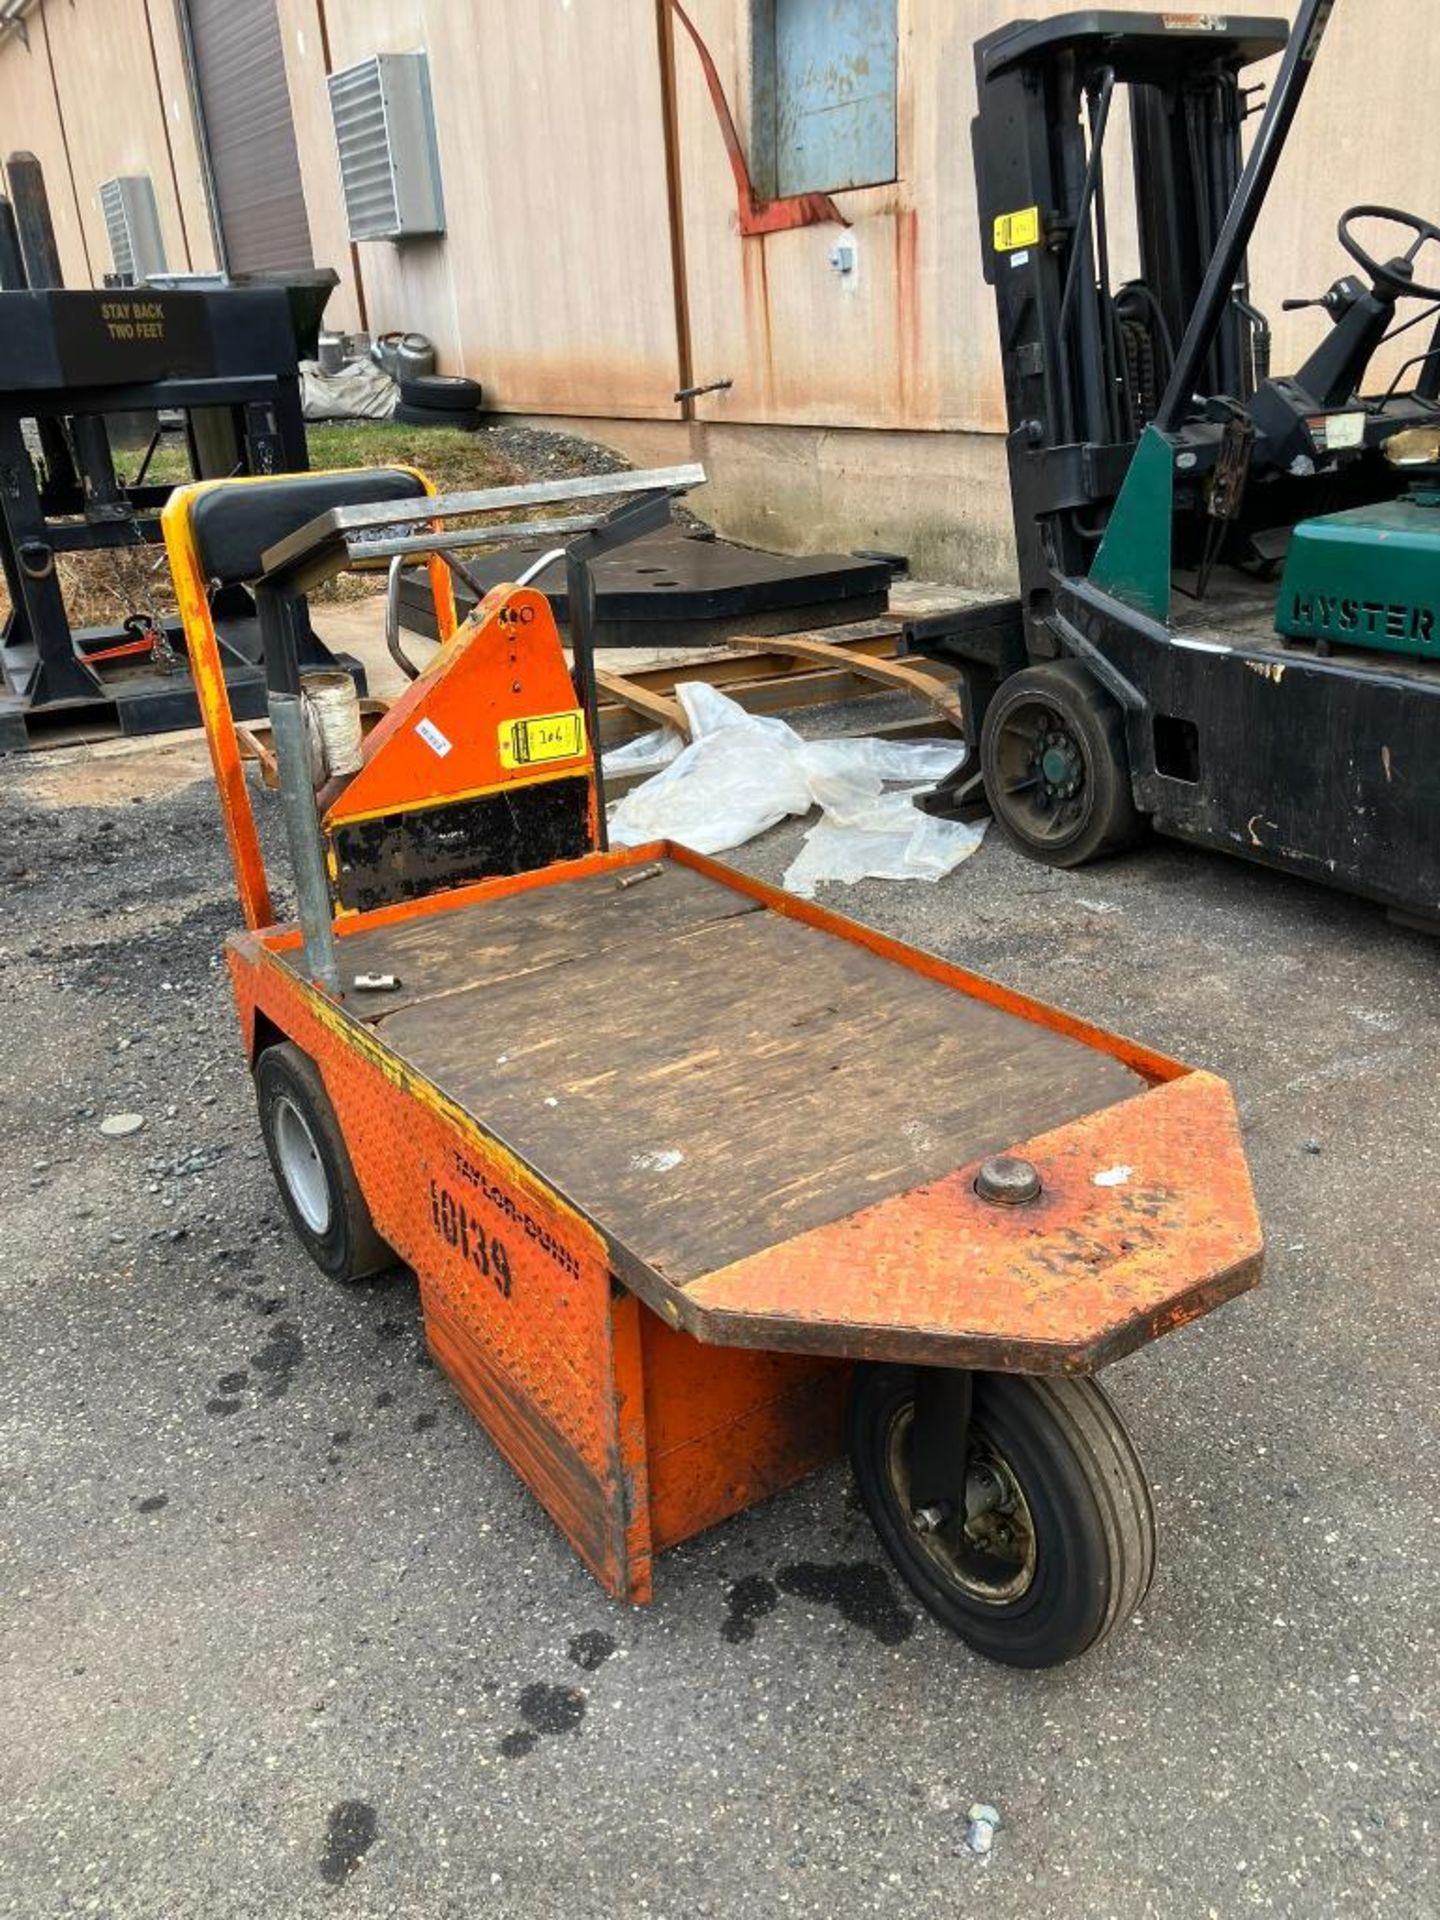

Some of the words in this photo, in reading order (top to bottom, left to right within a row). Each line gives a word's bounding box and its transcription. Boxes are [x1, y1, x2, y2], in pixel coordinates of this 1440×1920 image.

[101, 303, 130, 319] STAY
[132, 303, 165, 319] BACK
[108, 323, 134, 340] TWO
[136, 323, 164, 338] FEET
[1291, 591, 1436, 643] HYSTER
